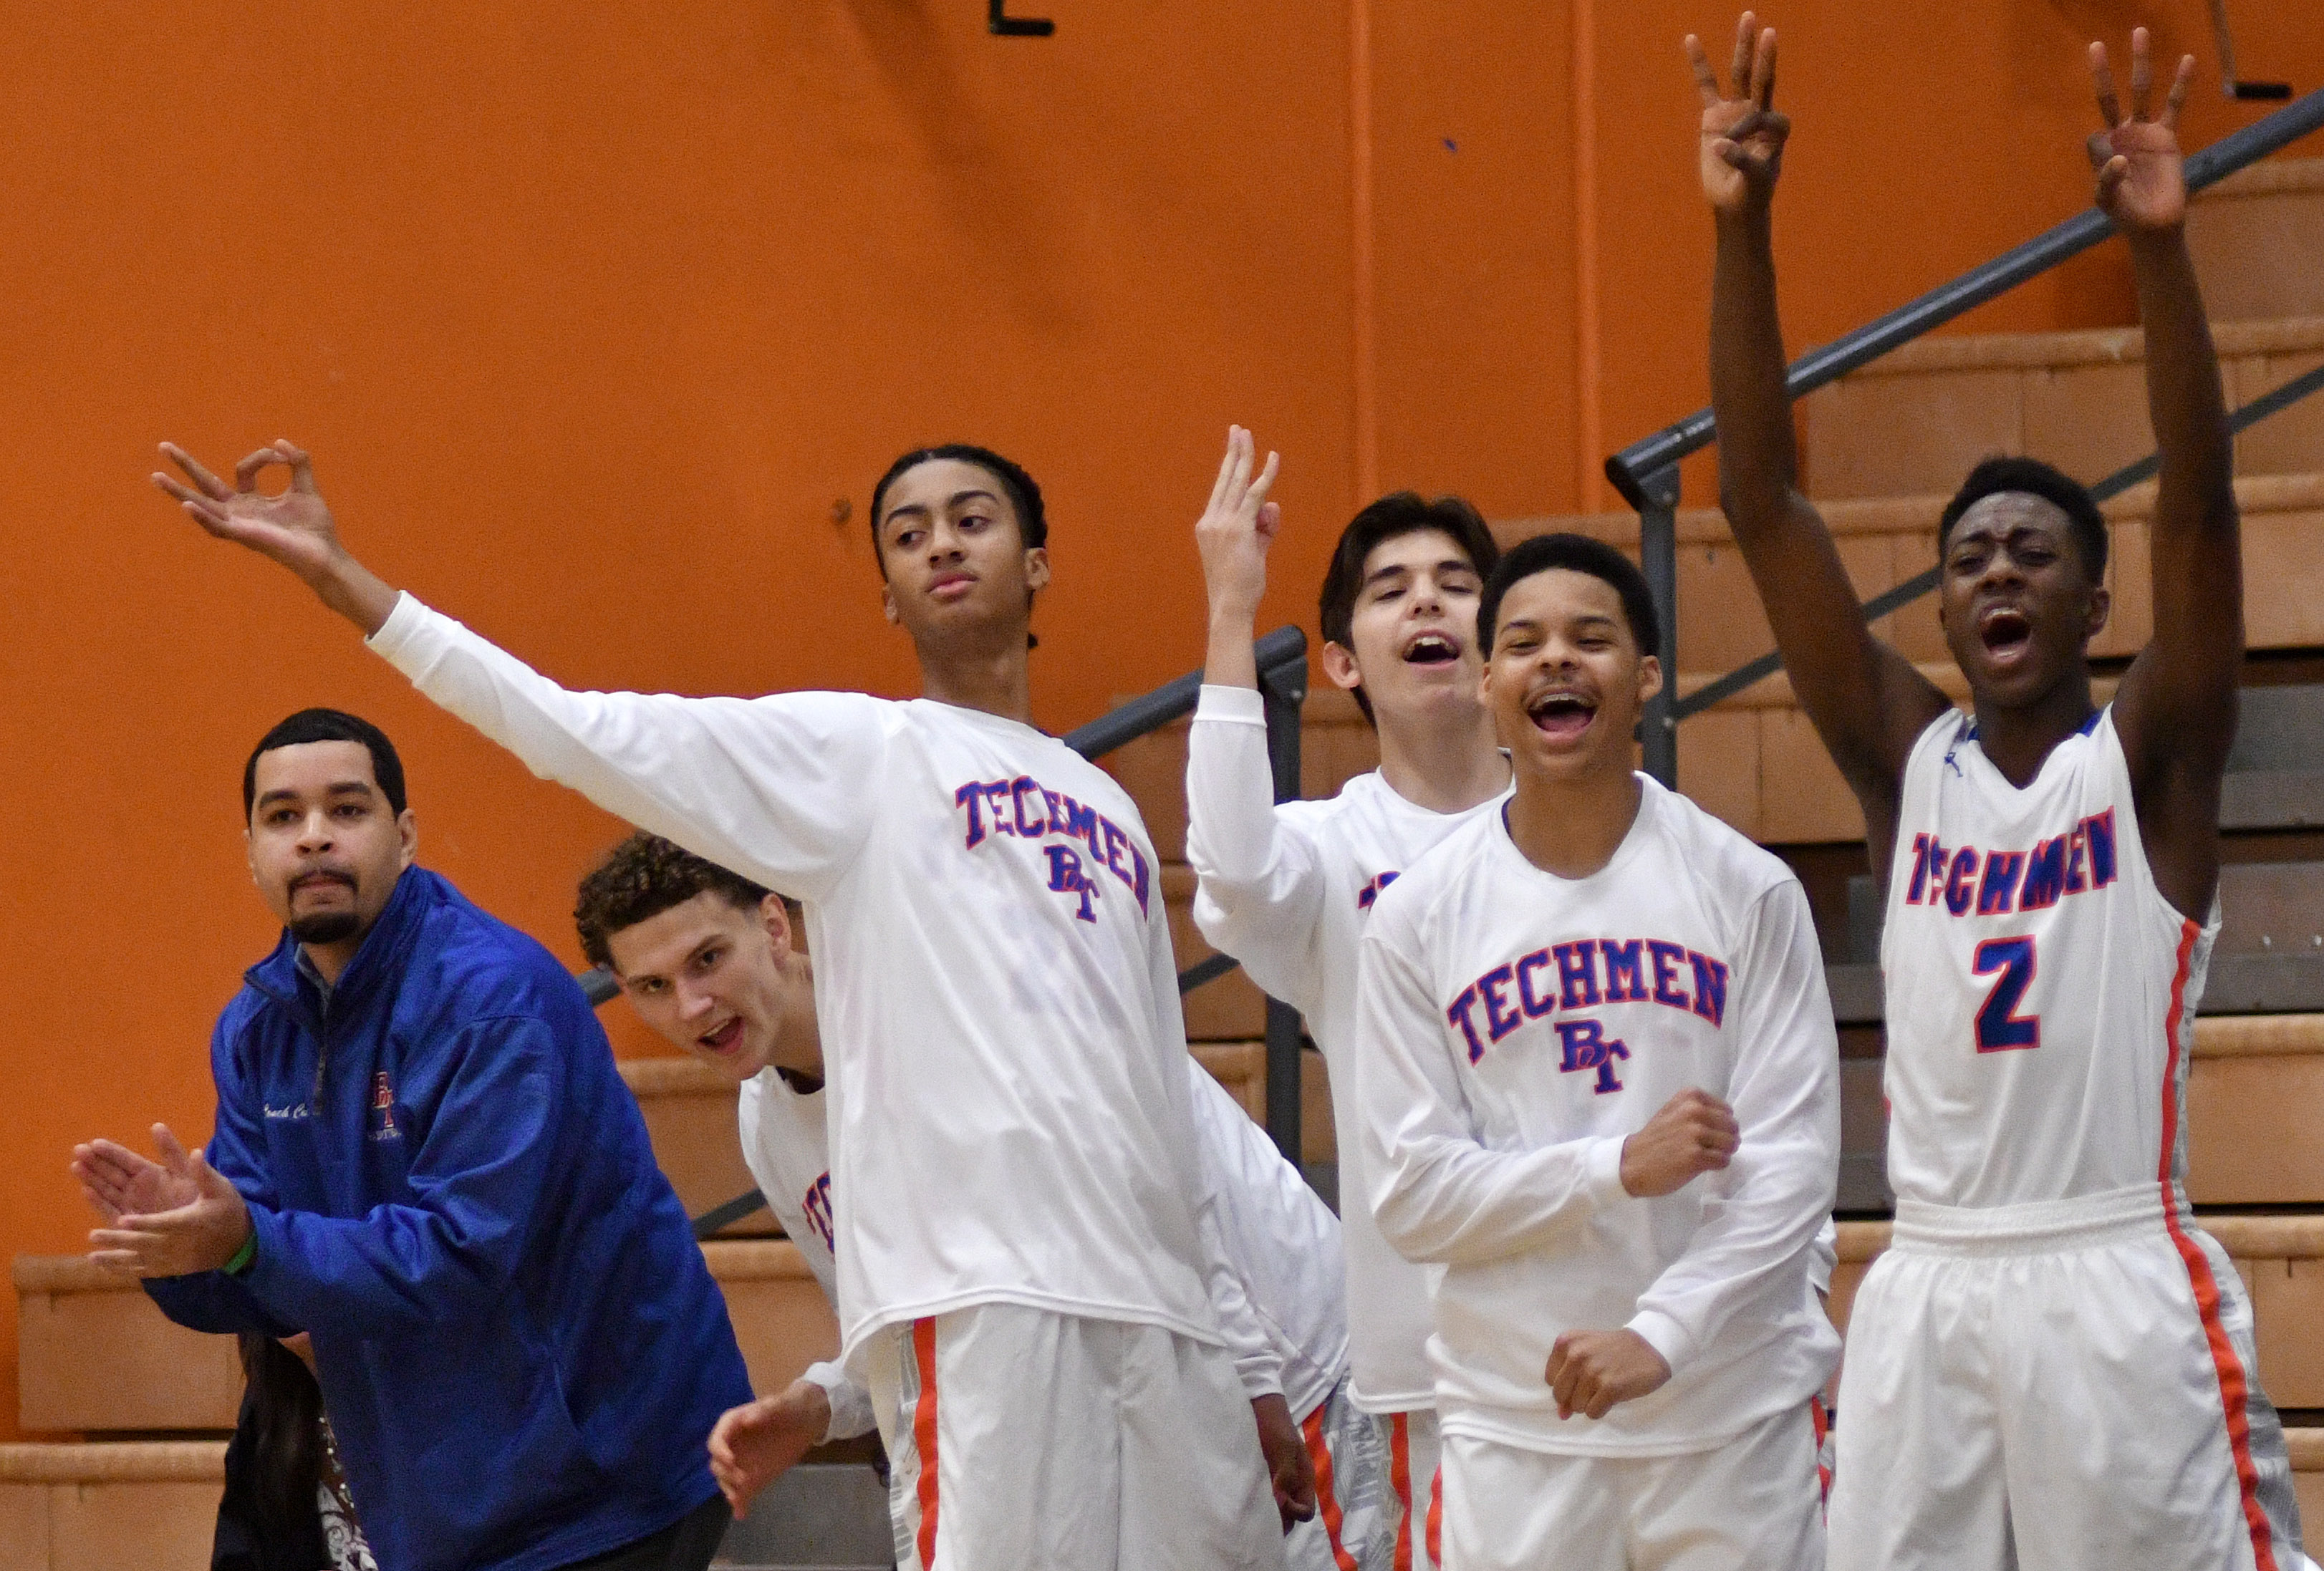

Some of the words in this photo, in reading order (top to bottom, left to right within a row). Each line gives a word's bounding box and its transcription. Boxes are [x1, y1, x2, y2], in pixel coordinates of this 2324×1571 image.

[1906, 806, 2118, 917] TECHMEN
[1447, 938, 1729, 1068] TECHMEN
[1972, 934, 2040, 1053] 2
